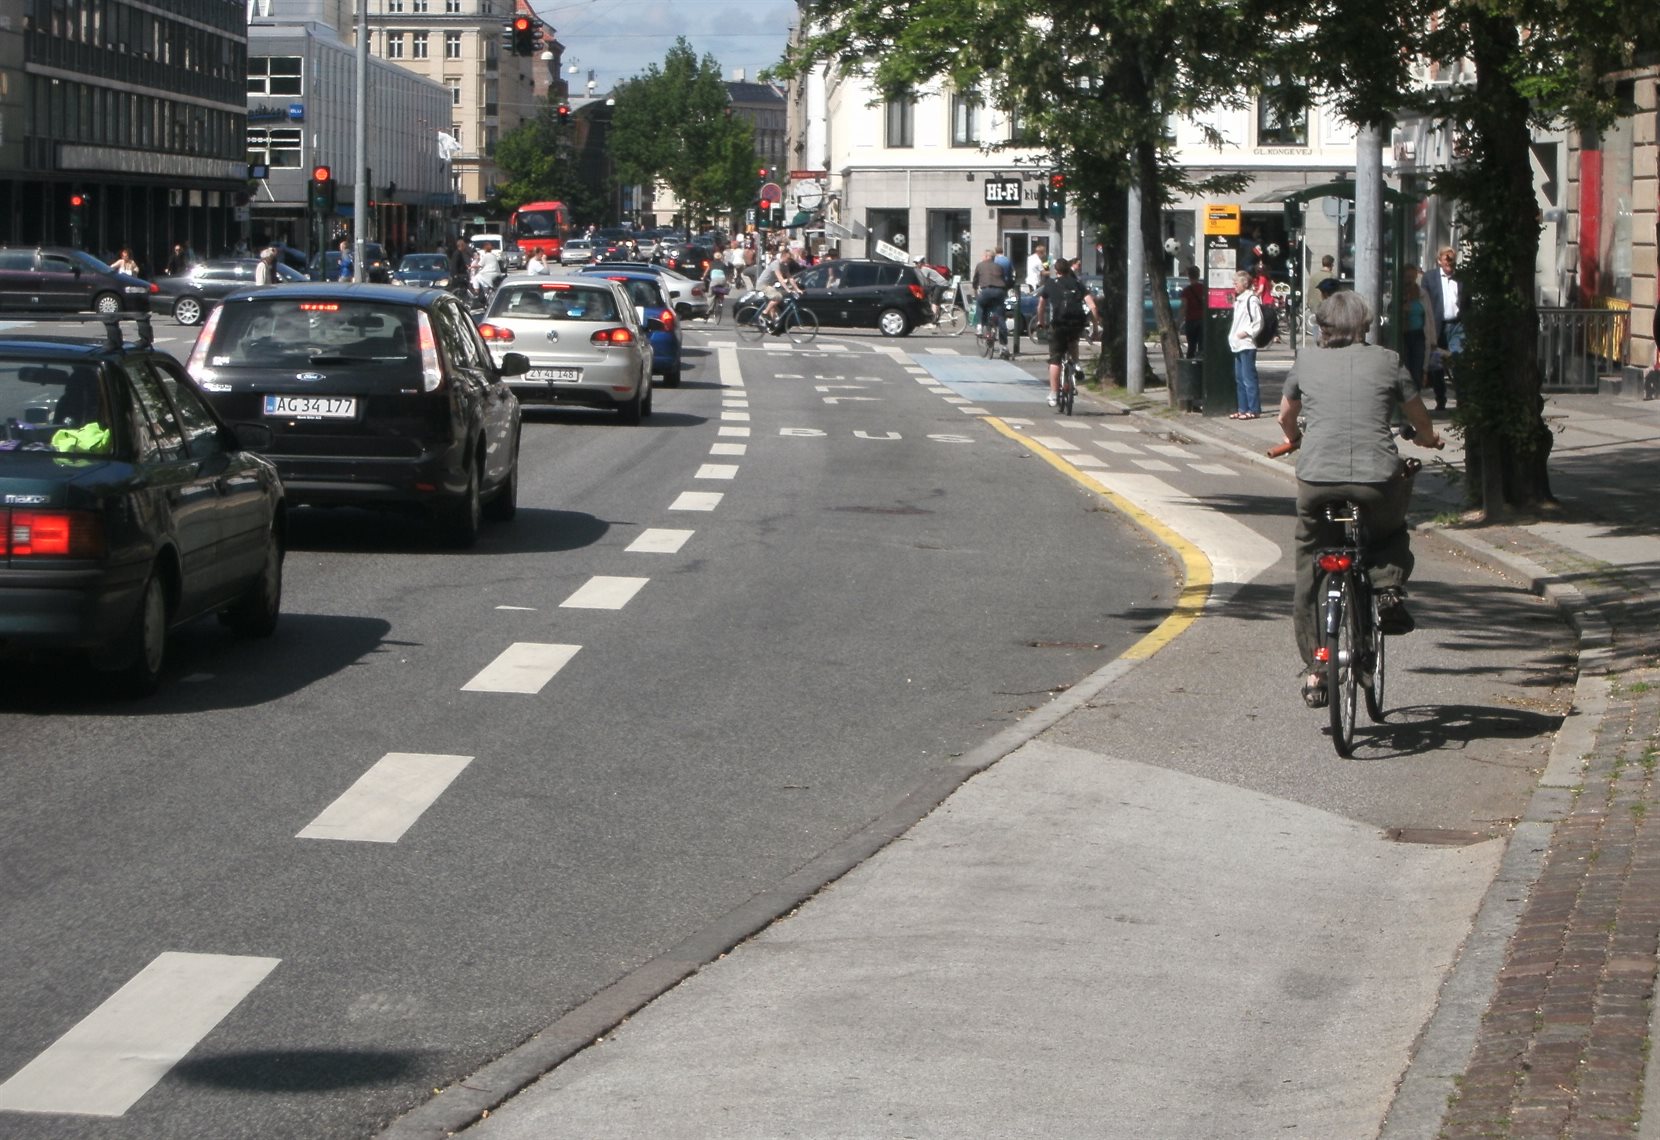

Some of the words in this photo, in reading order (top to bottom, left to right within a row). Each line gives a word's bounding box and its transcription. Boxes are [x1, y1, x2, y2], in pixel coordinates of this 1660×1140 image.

[1024, 189, 1039, 201] klu
[277, 398, 298, 412] AG
[302, 398, 320, 413] 34
[326, 399, 352, 413] 177
[779, 427, 976, 444] BUS
